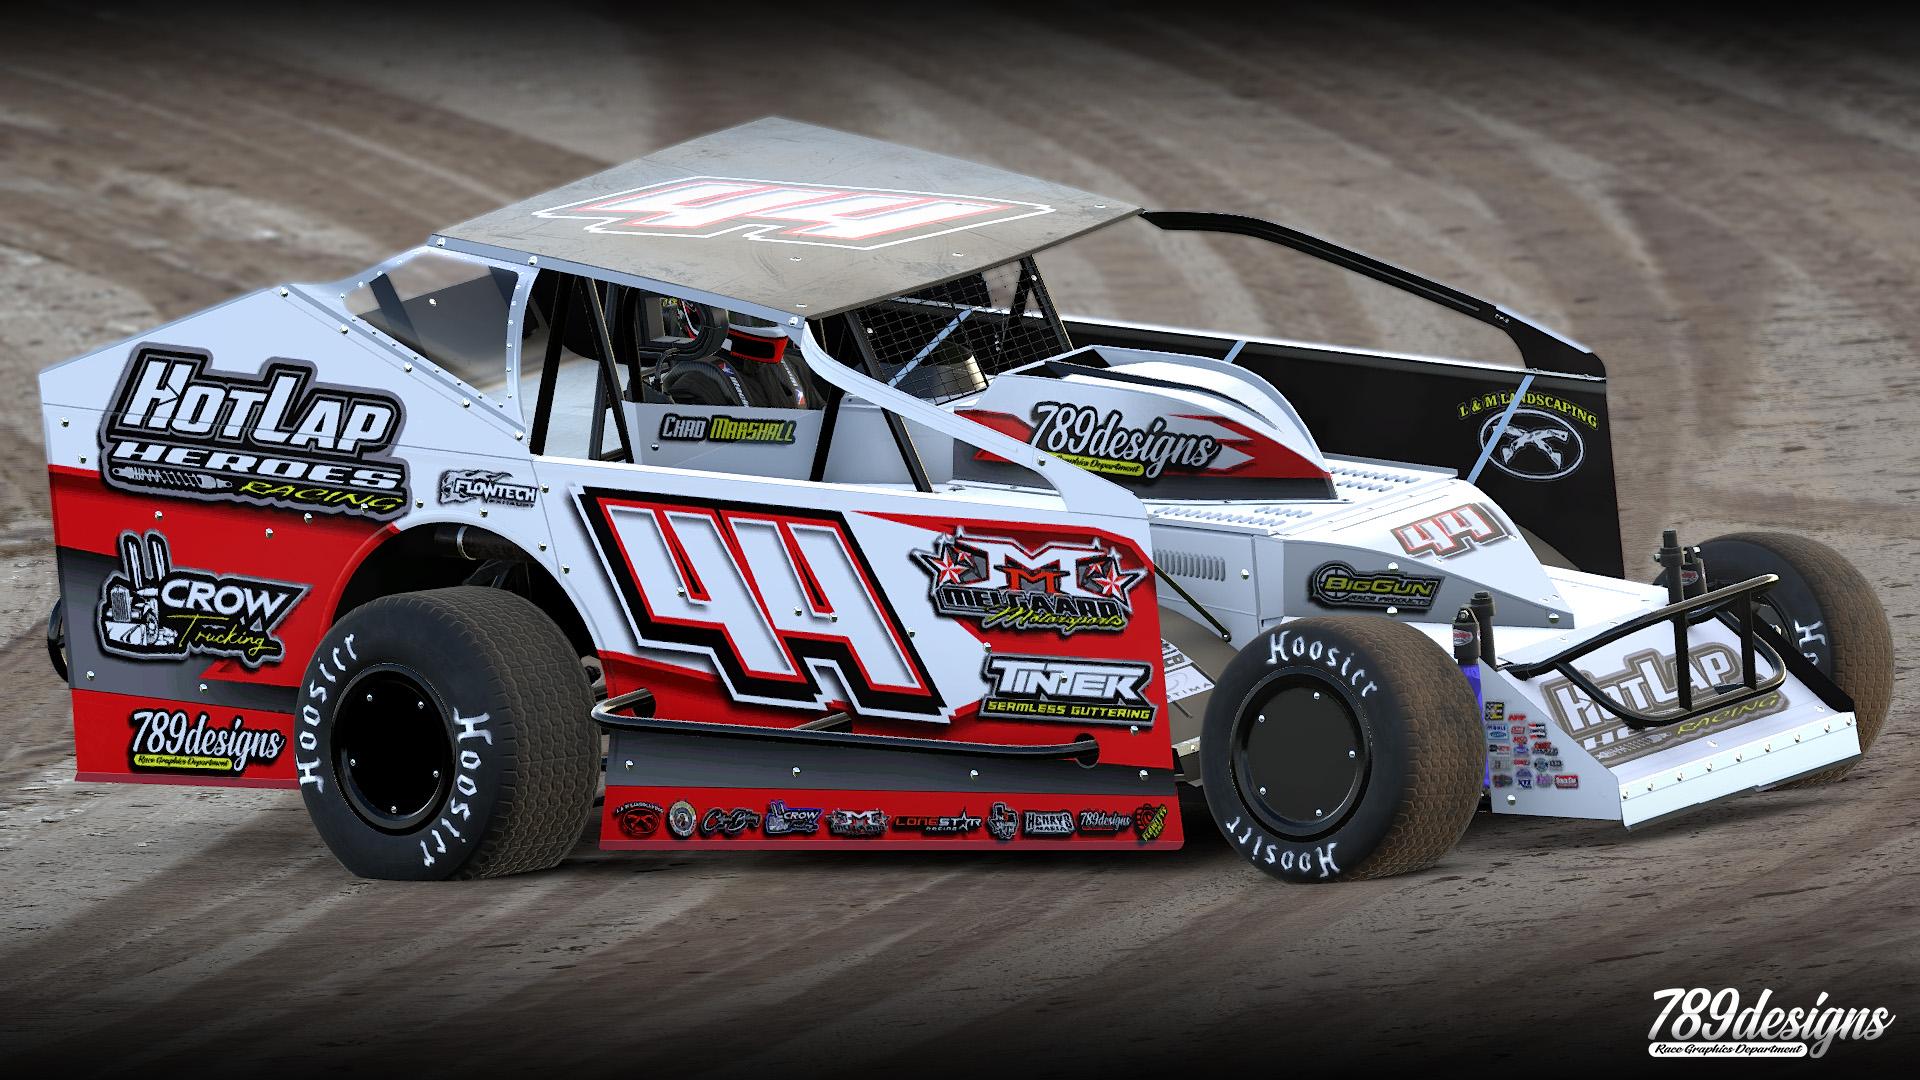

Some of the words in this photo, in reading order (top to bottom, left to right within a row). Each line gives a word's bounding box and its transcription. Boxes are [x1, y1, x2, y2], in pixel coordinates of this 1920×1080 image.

[548, 178, 1036, 245] 44
[709, 416, 795, 442] MARSHALL
[1459, 404, 1469, 419] L
[1471, 400, 1482, 412] &
[1485, 395, 1498, 408] M
[112, 440, 402, 490] HEROES
[1031, 405, 1220, 479] 789designs
[239, 480, 404, 511] RACING
[455, 479, 536, 502] FLOWTECH
[1392, 504, 1504, 557] 44
[161, 579, 290, 620] CROW
[594, 496, 935, 700] 44
[167, 614, 277, 656] Trucking
[1266, 630, 1377, 697] Hoosier
[296, 633, 357, 794] Hoosier
[987, 700, 1066, 716] SEAMLESS
[1070, 704, 1150, 721] GUTTERING
[1677, 694, 1779, 736] RACING
[132, 711, 285, 771] 789designs
[419, 706, 493, 867] Hoosier
[1226, 817, 1340, 878] Hoosier
